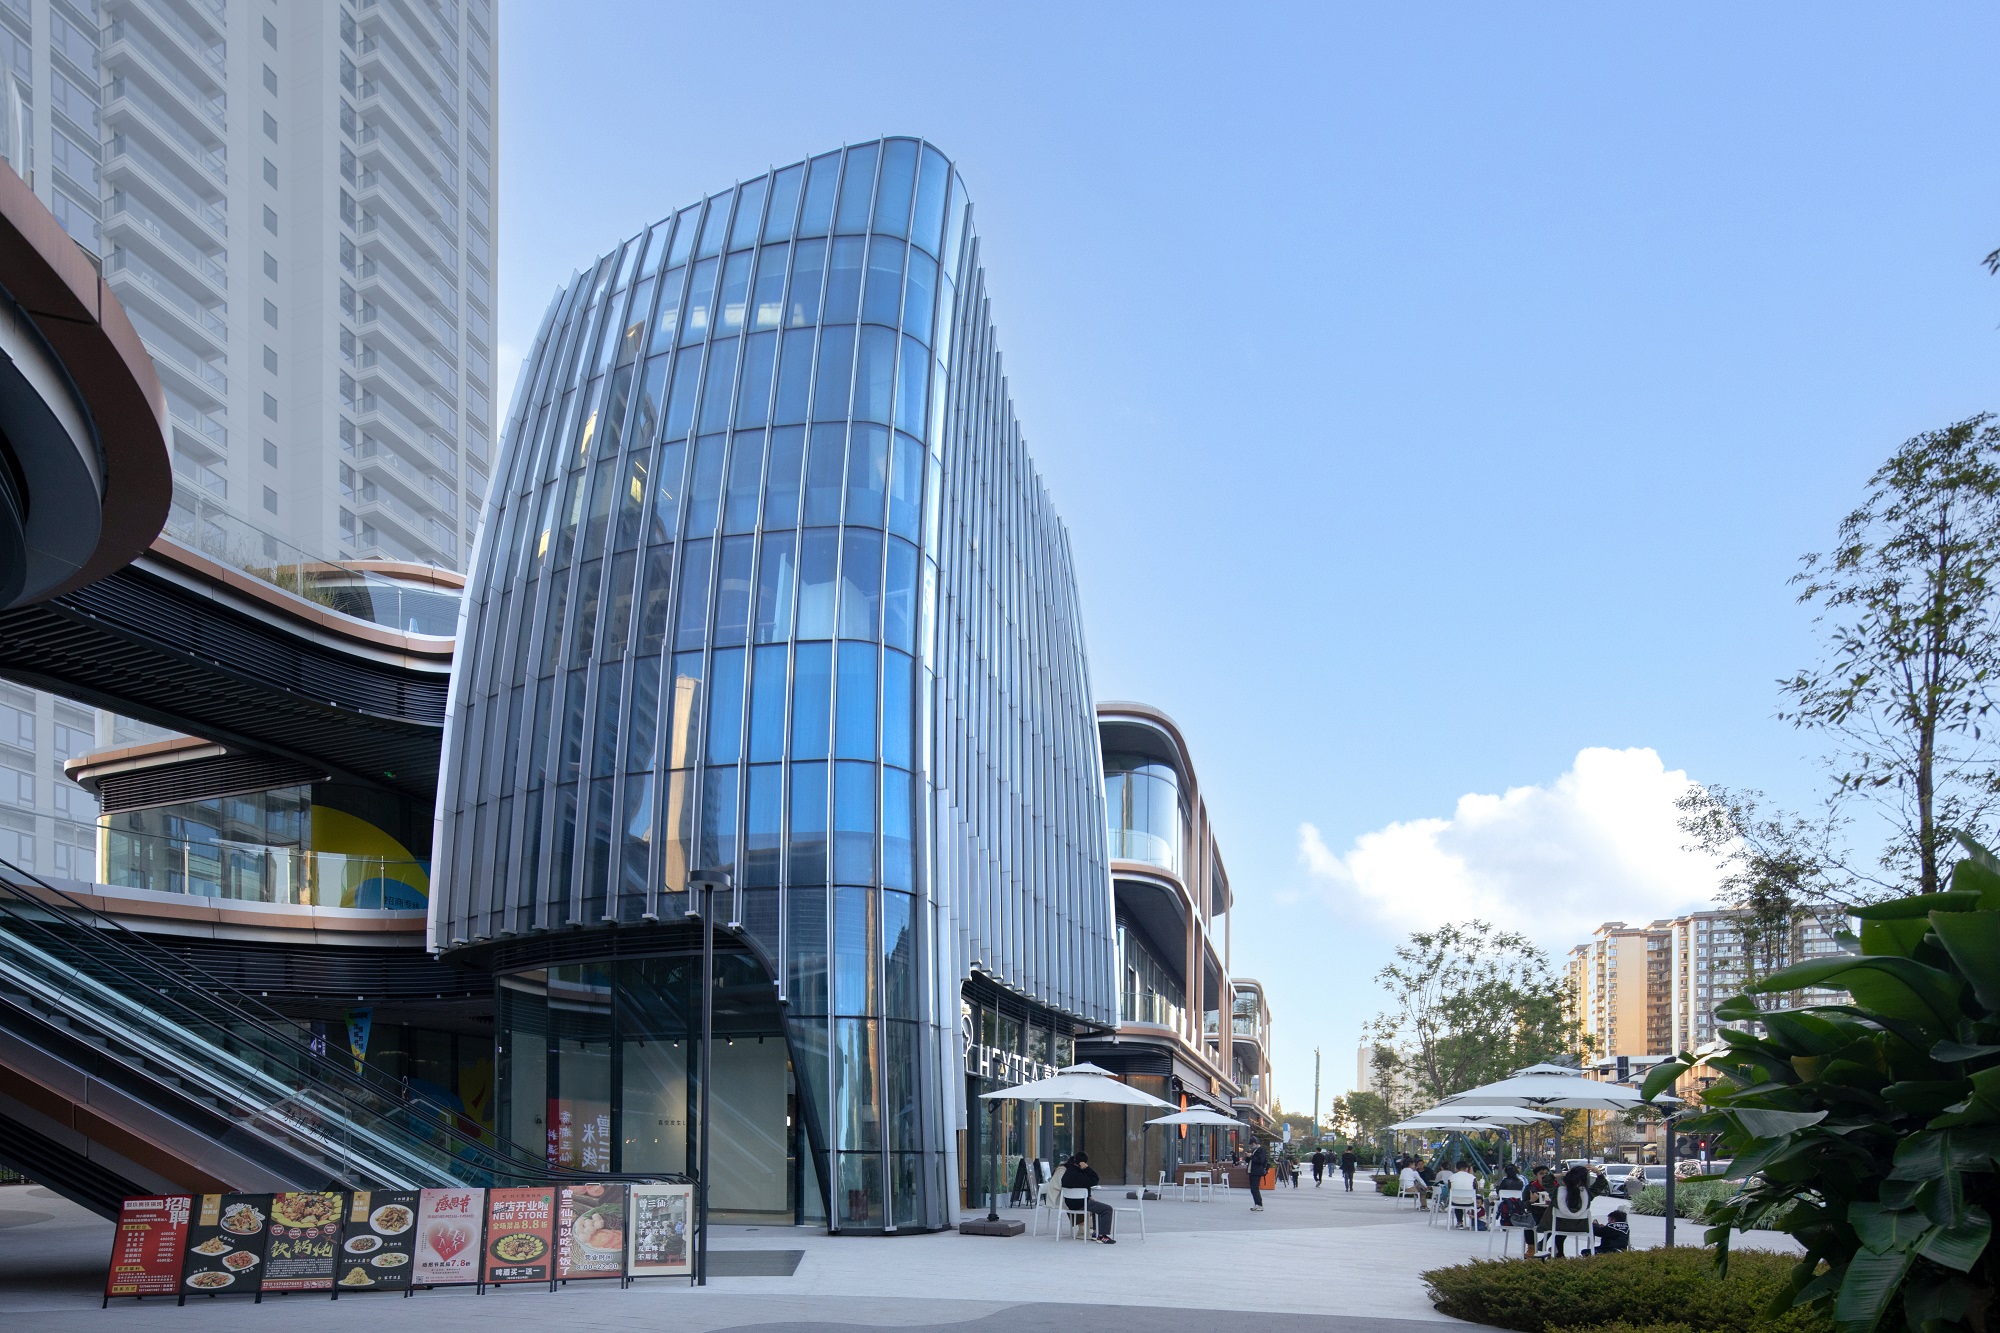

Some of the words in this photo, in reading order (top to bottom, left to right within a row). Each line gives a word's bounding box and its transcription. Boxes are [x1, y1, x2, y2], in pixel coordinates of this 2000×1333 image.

[435, 1194, 471, 1213] 感恩节
[493, 1200, 549, 1212] 新店开业啦
[638, 1199, 666, 1208] 曾三仙
[165, 1197, 190, 1230] 招聘
[518, 1211, 548, 1220] STORE
[559, 1189, 573, 1276] 曾三仙可以吃早饭了
[271, 1239, 334, 1259] 铁锅炖
[496, 1268, 540, 1276] 啤酒买一送一
